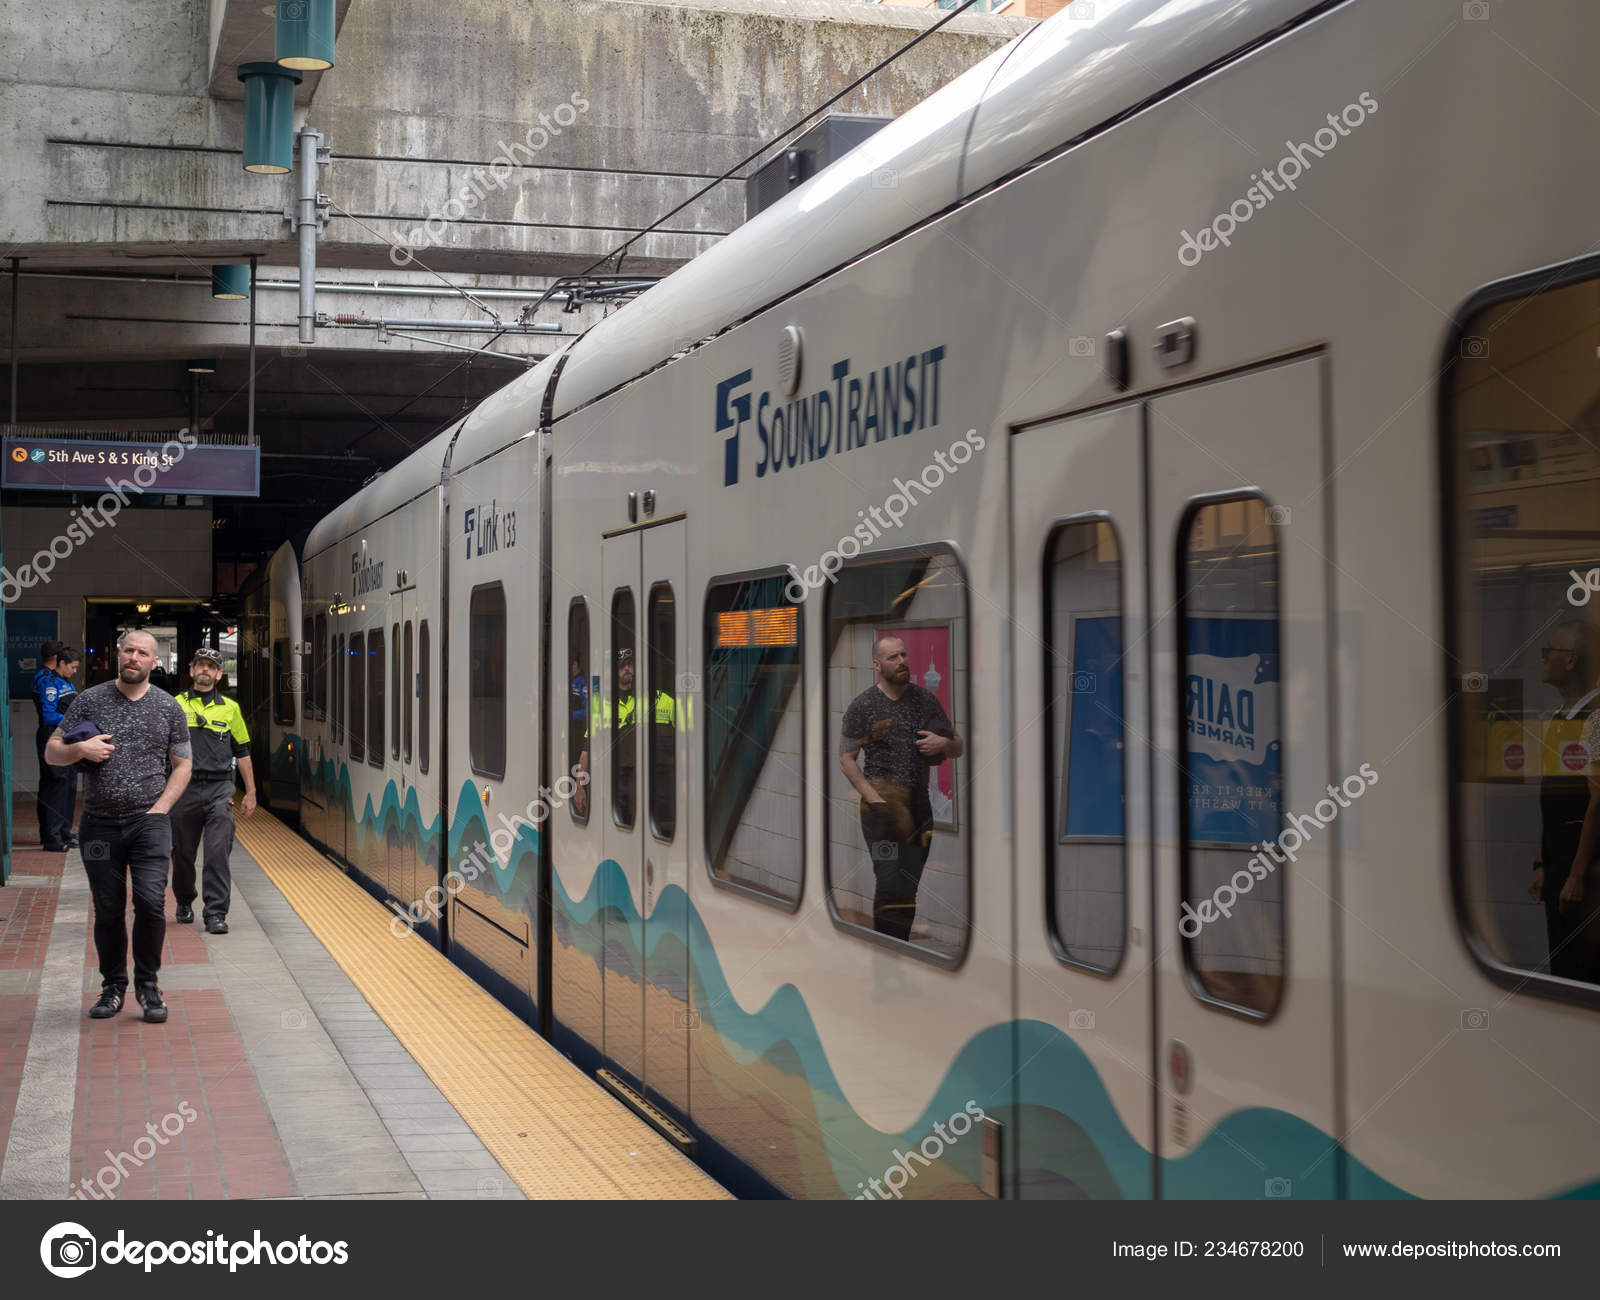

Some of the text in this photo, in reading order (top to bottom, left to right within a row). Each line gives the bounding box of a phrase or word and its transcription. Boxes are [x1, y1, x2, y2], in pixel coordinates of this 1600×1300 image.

[48, 449, 174, 469] 5th Ave S & S King St
[477, 499, 516, 557] Link 133
